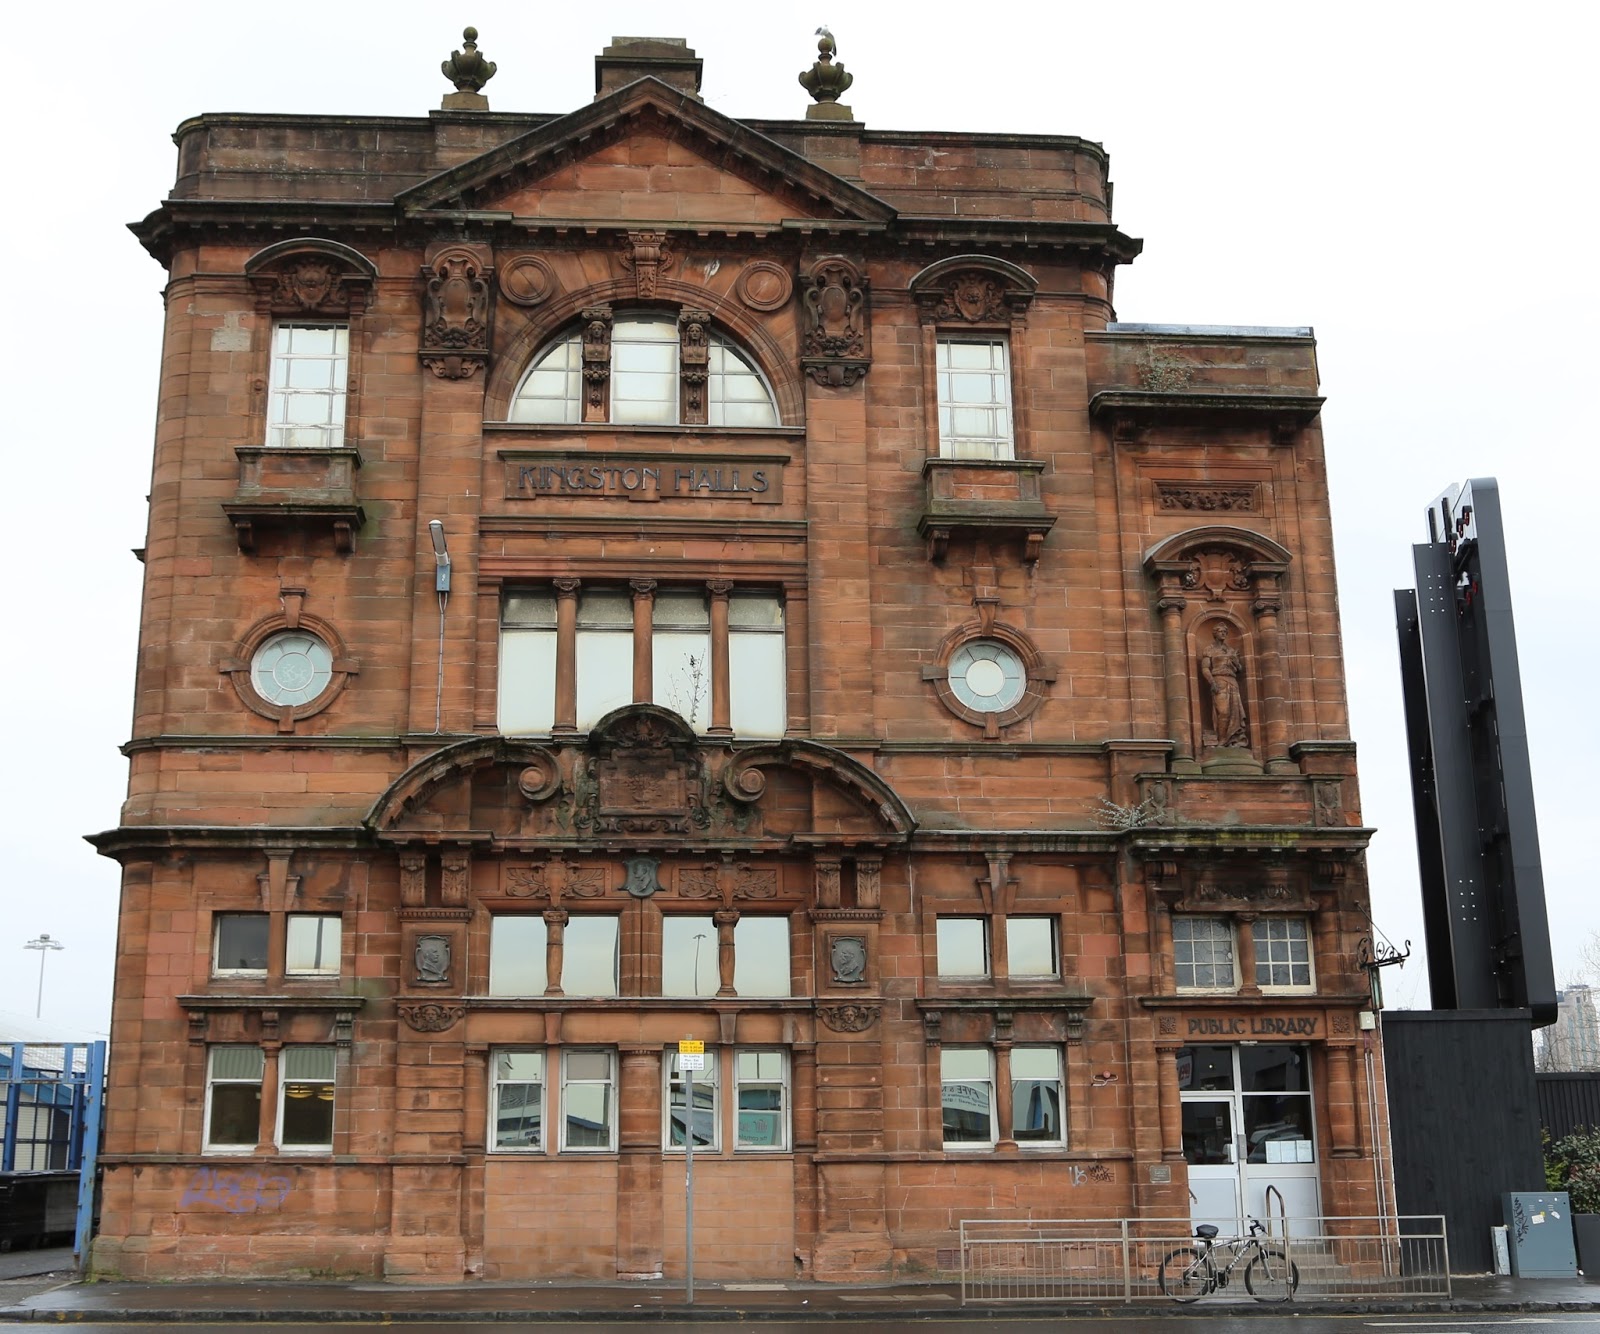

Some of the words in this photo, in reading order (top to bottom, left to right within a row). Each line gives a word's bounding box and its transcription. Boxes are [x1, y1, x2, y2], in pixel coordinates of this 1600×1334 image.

[518, 465, 661, 491] KINGSTON
[674, 467, 770, 493] HALLS
[1187, 1017, 1246, 1035] PUBLIC
[1250, 1016, 1318, 1036] LIBRARY
